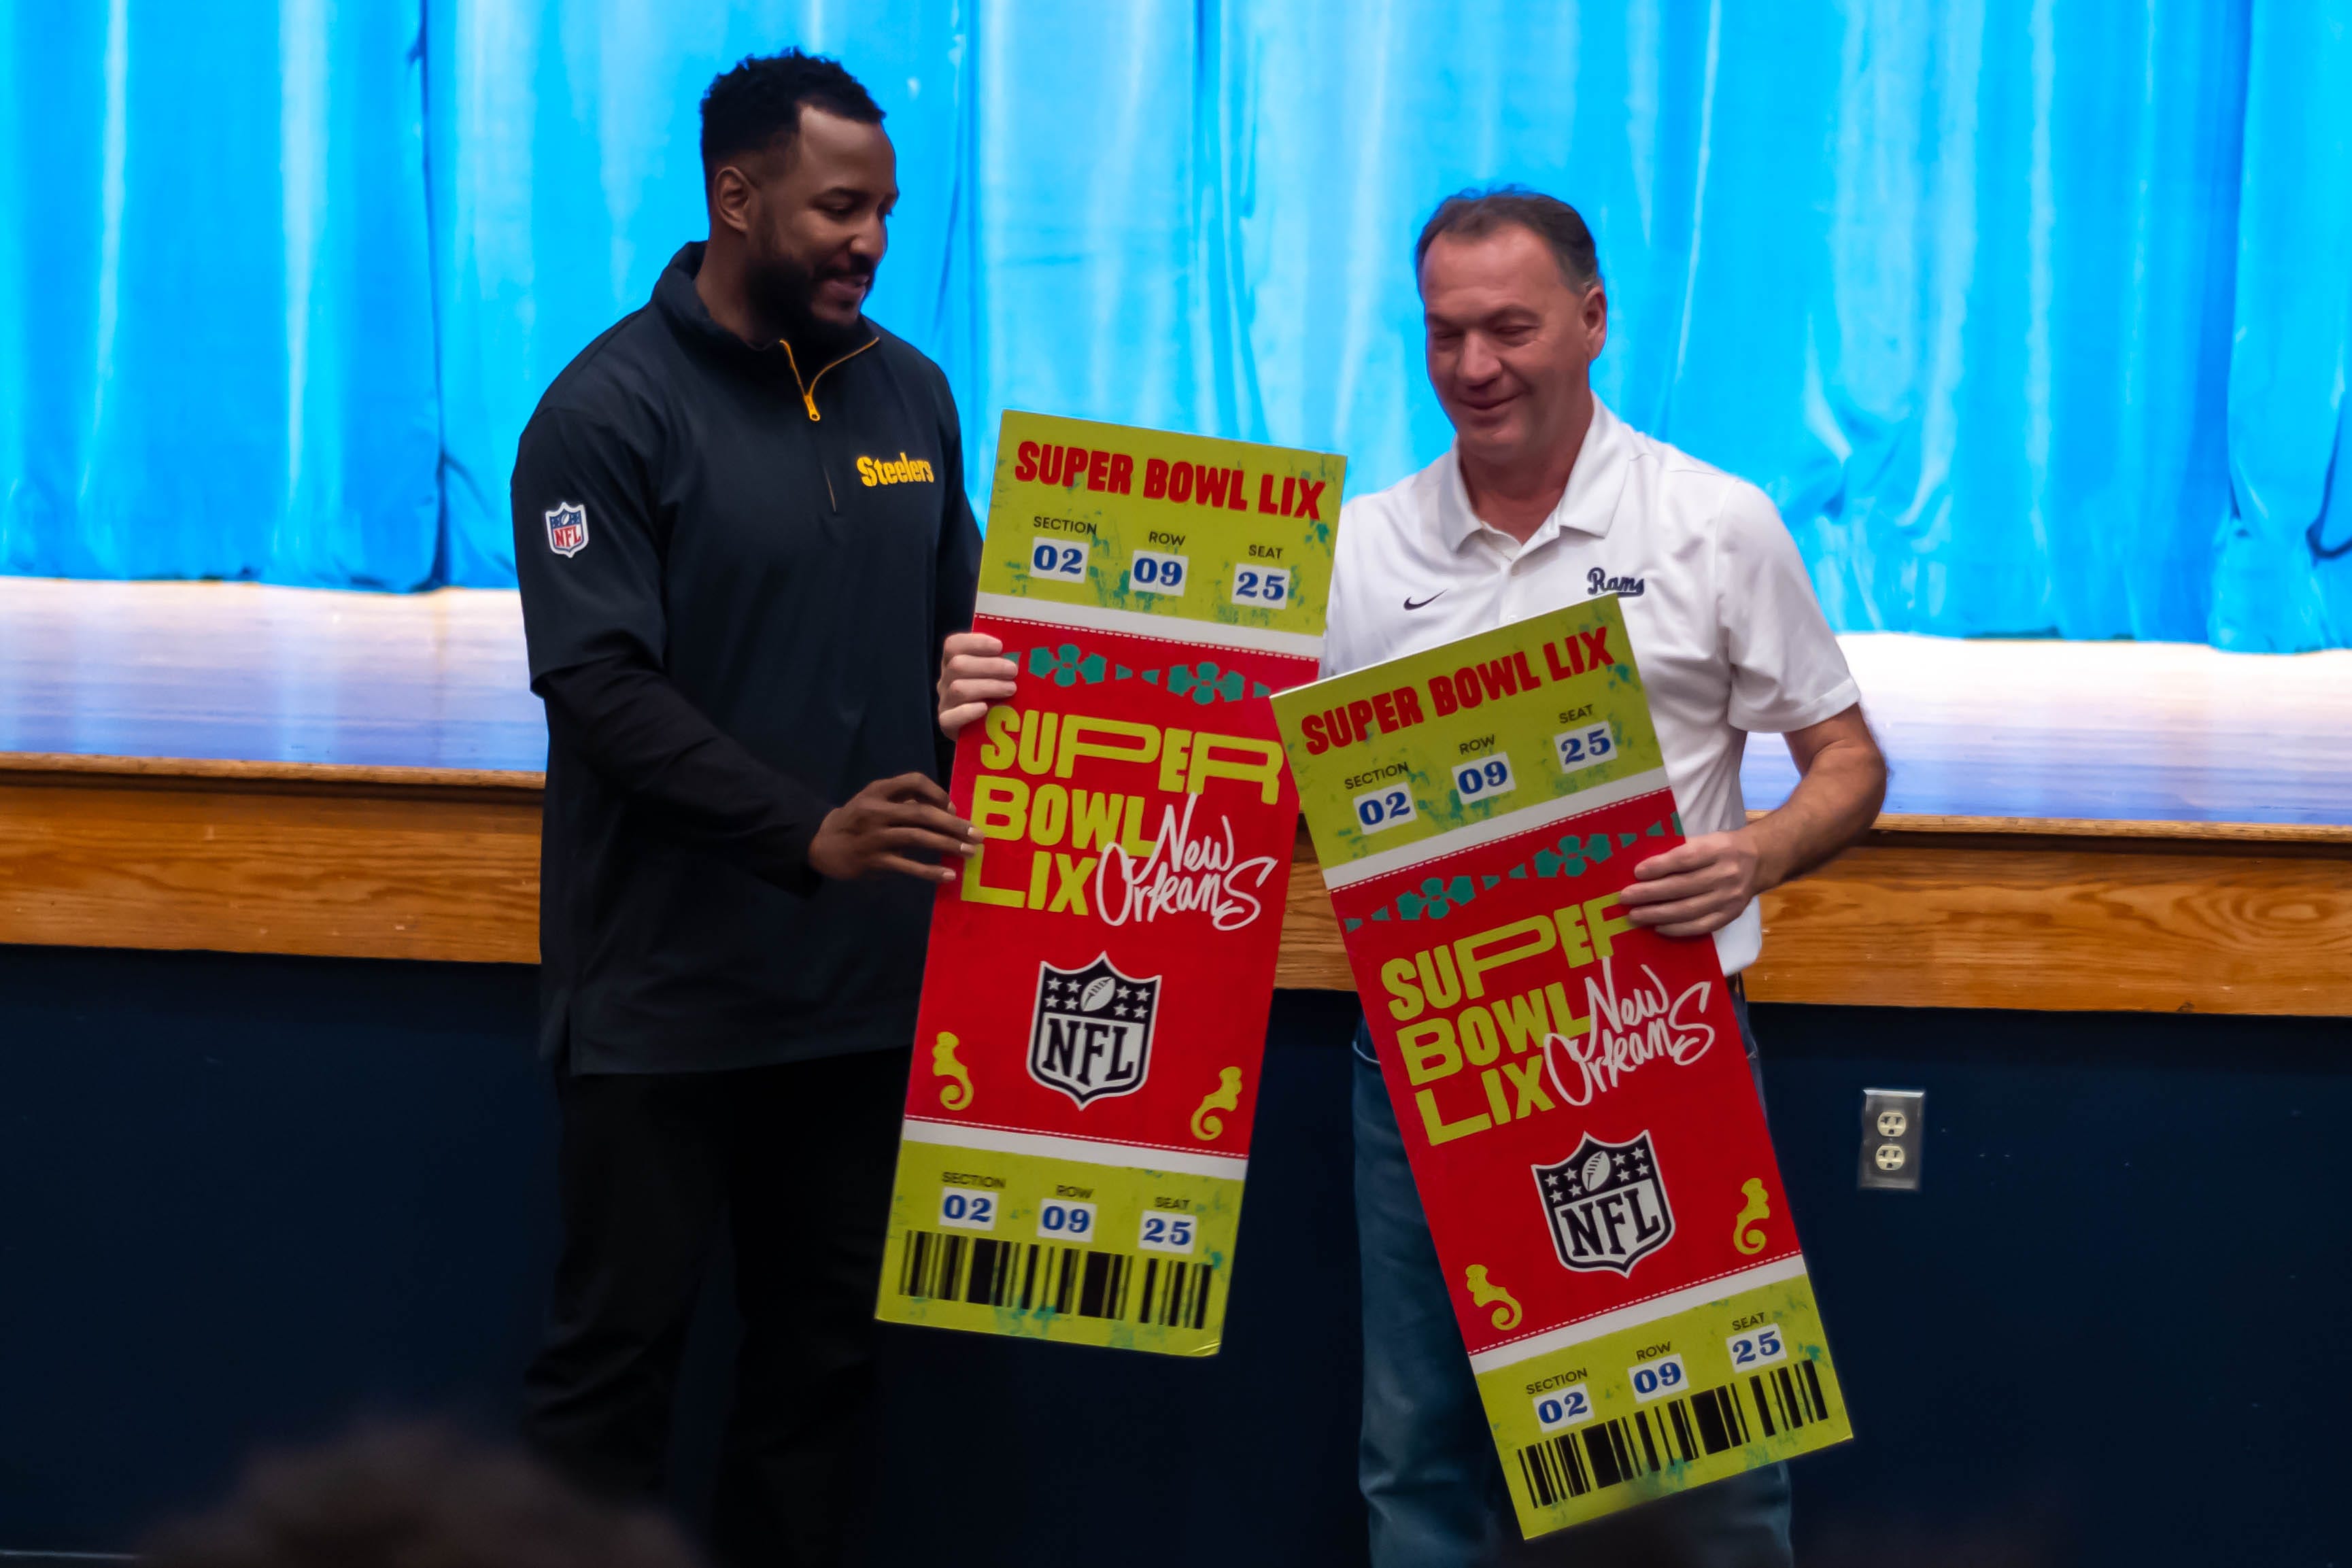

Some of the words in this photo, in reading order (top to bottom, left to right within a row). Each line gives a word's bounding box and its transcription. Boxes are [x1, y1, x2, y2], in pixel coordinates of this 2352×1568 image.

[857, 452, 934, 487] Steelers
[1015, 441, 1133, 494] SUPER
[1144, 458, 1247, 511] BOWL
[1258, 475, 1326, 521] LIX
[554, 524, 581, 549] NFL
[1034, 516, 1097, 534] SECTION
[1148, 532, 1186, 546] ROW
[1034, 545, 1083, 575] 02
[1248, 544, 1283, 560] SEAT
[1134, 558, 1183, 586] 09
[1235, 572, 1284, 602] 25
[1587, 568, 1645, 596] Rams
[1301, 685, 1424, 755] SUPER
[1429, 650, 1541, 717] BOWL
[1543, 626, 1614, 681] LIX
[1559, 704, 1595, 724] SEAT
[981, 706, 1284, 805] SUPER
[1459, 734, 1496, 755] ROW
[1561, 729, 1612, 764] 25
[1344, 762, 1410, 790] SECTION
[1459, 761, 1507, 795] 09
[972, 775, 1156, 858] BOWL
[1359, 791, 1410, 825] 02
[1130, 790, 1234, 885] New
[961, 844, 1097, 915] LIX
[1582, 955, 1669, 1059] New
[1396, 981, 1591, 1087] BOWL
[1042, 1019, 1134, 1087] NFL
[1415, 1055, 1555, 1146] LIX
[942, 1172, 1006, 1189] SECTION
[1056, 1185, 1095, 1199] ROW
[943, 1194, 992, 1223] 02
[1155, 1197, 1190, 1210] SEAT
[1042, 1206, 1091, 1233] 09
[1142, 1218, 1191, 1246] 25
[1561, 1187, 1660, 1258] NFL
[1732, 1312, 1766, 1331] SEAT
[1636, 1341, 1671, 1360] ROW
[1733, 1331, 1781, 1365] 25
[1526, 1367, 1588, 1396] SECTION
[1633, 1362, 1682, 1394] 09
[1538, 1393, 1588, 1424] 02
